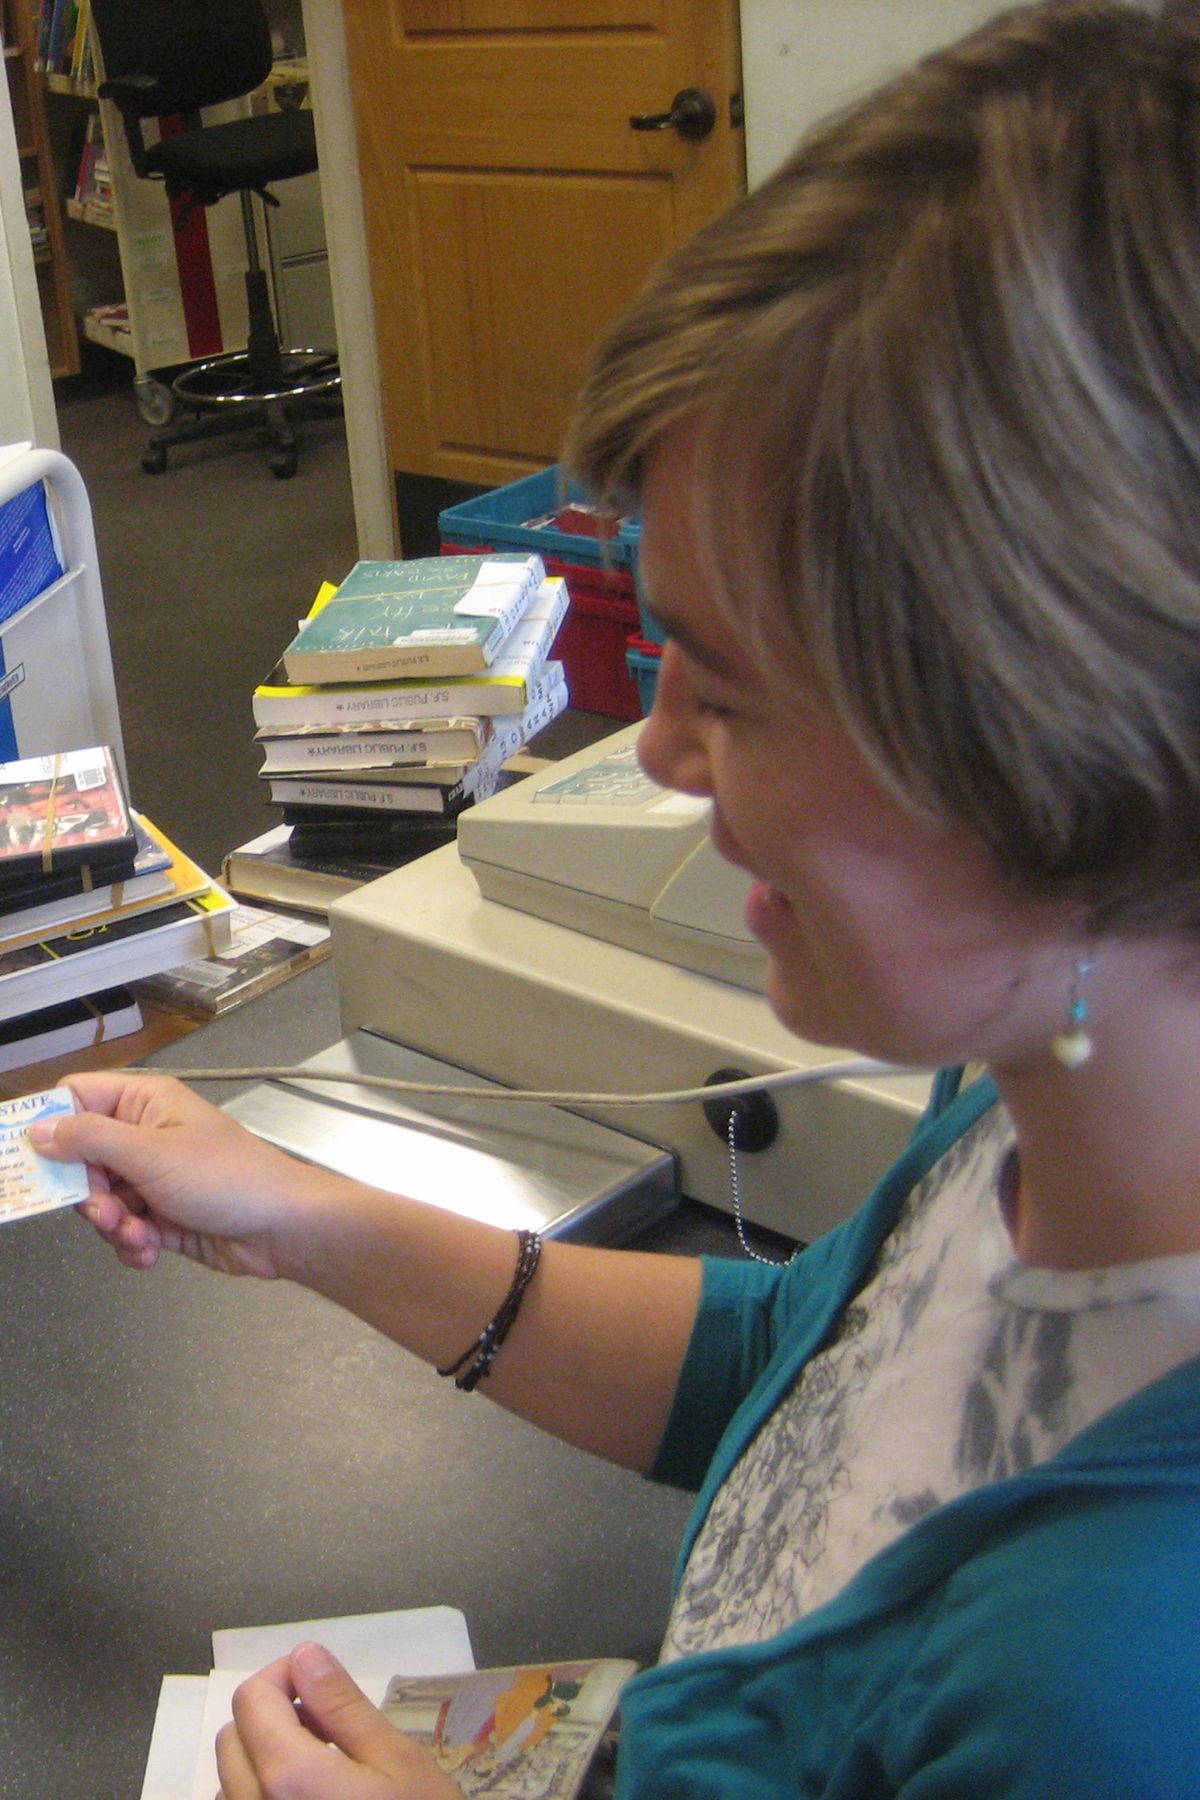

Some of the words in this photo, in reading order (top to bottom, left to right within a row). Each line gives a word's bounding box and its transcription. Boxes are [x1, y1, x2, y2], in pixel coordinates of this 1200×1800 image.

[347, 698, 390, 711] LIBRARY
[392, 693, 428, 708] PUBLIC
[314, 744, 362, 756] LIBRARY
[364, 743, 404, 754] PUBLIC
[308, 788, 342, 800] LIBRARY
[345, 789, 376, 803] PUBLIC
